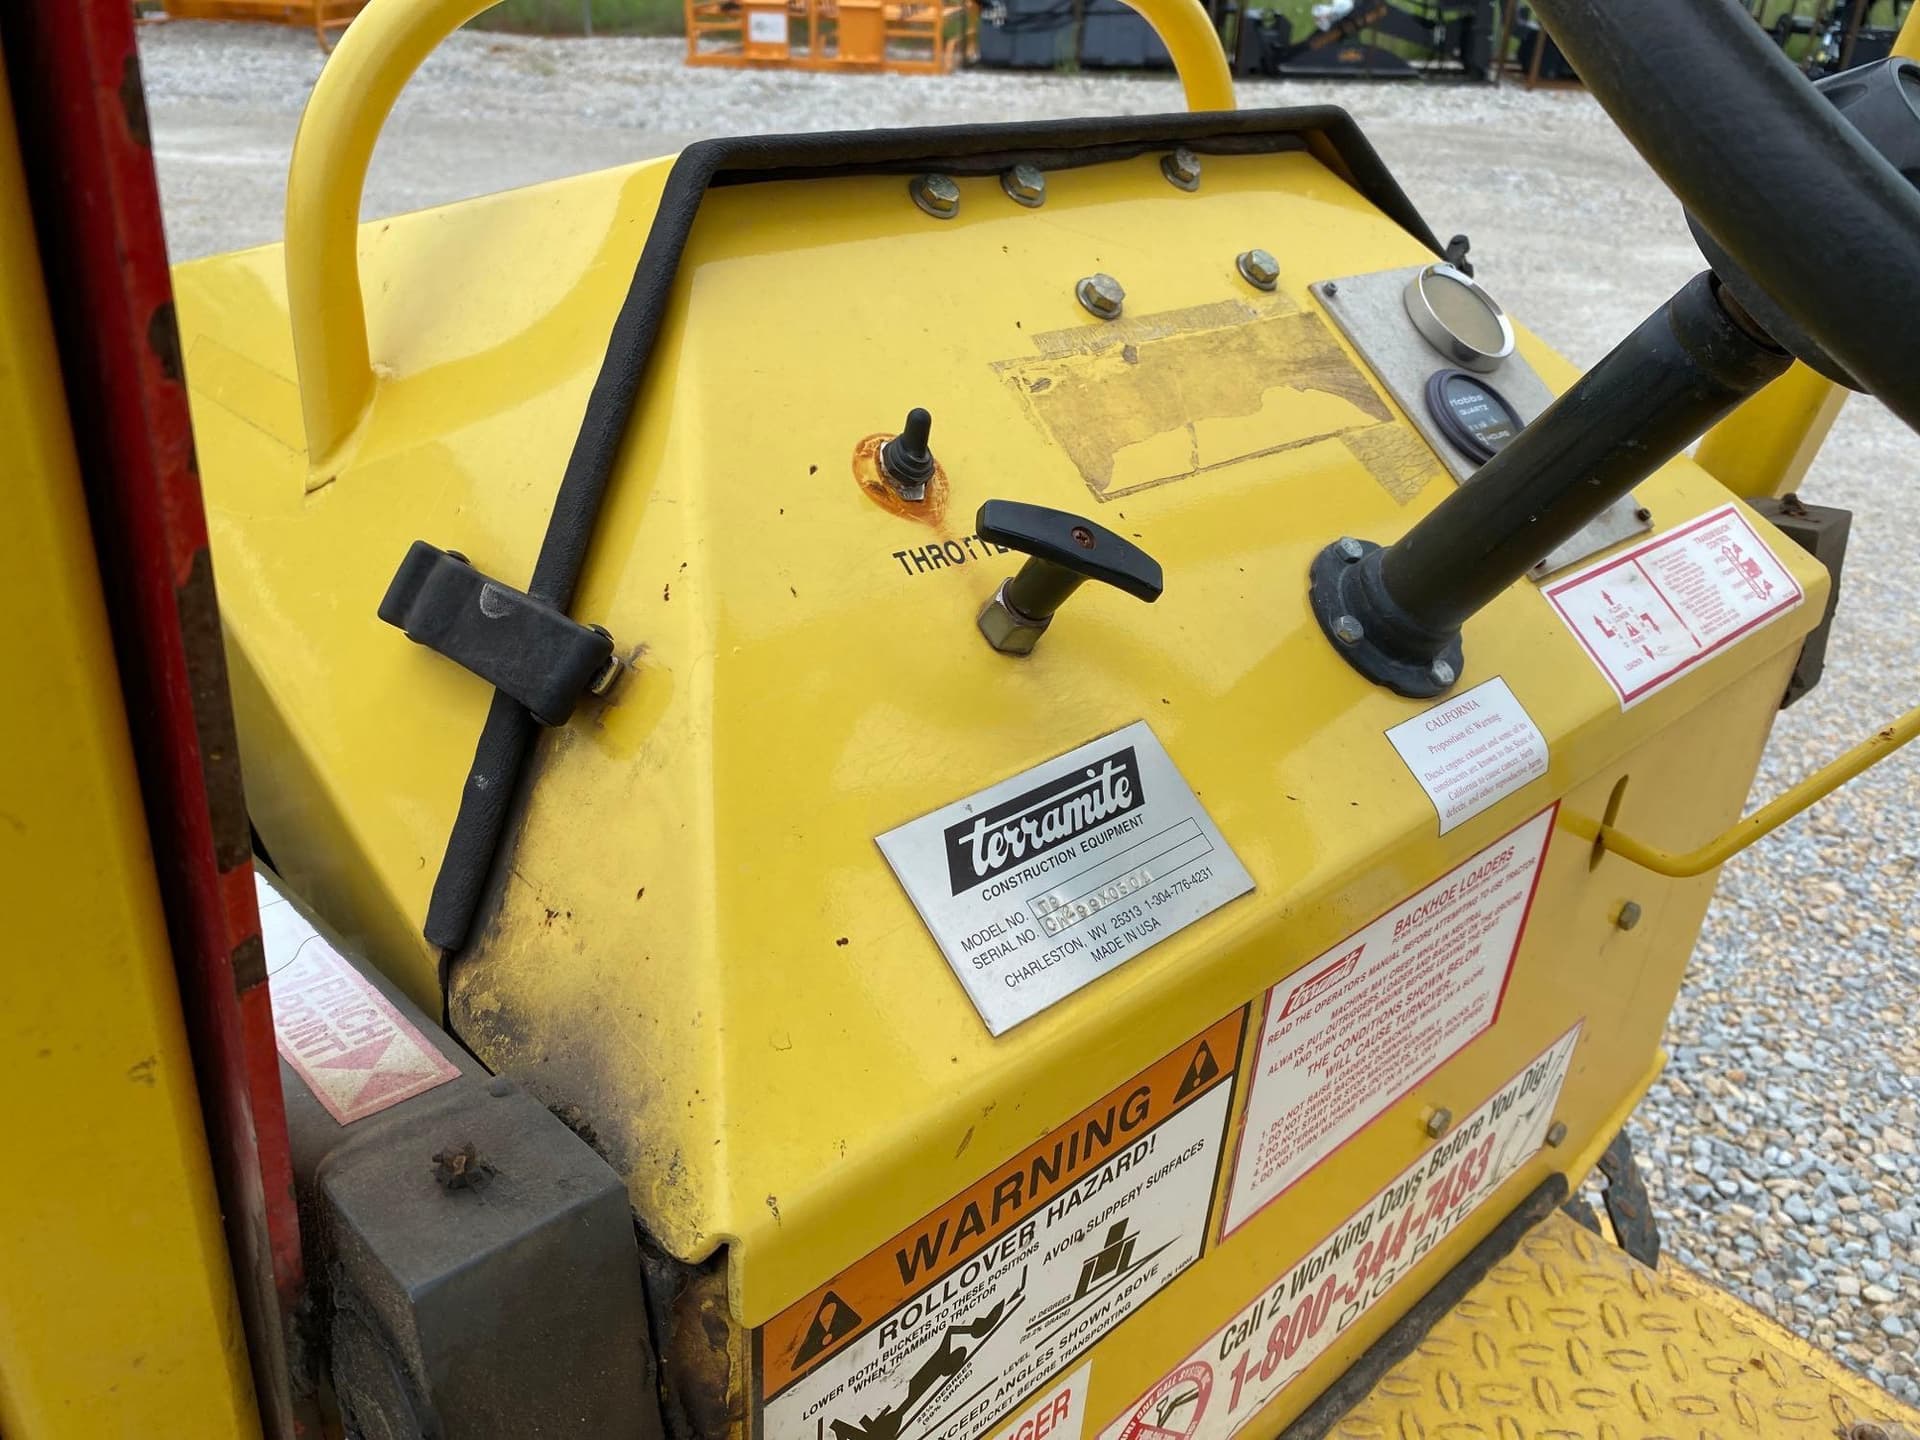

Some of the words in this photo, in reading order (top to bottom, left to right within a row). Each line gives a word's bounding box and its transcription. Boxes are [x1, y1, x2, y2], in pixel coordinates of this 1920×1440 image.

[1424, 699, 1480, 733] CALIFORNIA
[1426, 730, 1466, 756] Proposition
[1423, 764, 1446, 783] Diesel
[1447, 780, 1479, 802] California
[959, 760, 1133, 877] terramite
[982, 847, 1077, 901] CONSTRUCTION
[1080, 813, 1143, 853] EQUIPMENT
[1393, 882, 1458, 937] BACKHOE
[1458, 845, 1516, 894] LOADERS
[960, 923, 1007, 952] MODEL
[1004, 911, 1030, 930] NO.
[972, 940, 1018, 970] SERIAL
[1015, 928, 1041, 947] NO.
[1005, 937, 1088, 987] CHARLESTON,
[1086, 922, 1108, 942] WV
[1110, 905, 1142, 929] 25313
[1144, 867, 1213, 910] 1-304-776-4231
[1090, 936, 1125, 962] MADE
[1122, 928, 1139, 944] IN
[1134, 916, 1162, 937] USA
[303, 976, 395, 1046] PINCH
[1266, 1021, 1293, 1047] READ
[1295, 1007, 1313, 1027] THE
[1367, 949, 1400, 978] MANUAL
[1401, 926, 1434, 954] BEFORE
[1306, 1051, 1331, 1078] THE
[1332, 999, 1404, 1059] CONDITIONS
[1404, 969, 1445, 1006] SHOWN
[1446, 943, 1482, 977] BELOW
[1330, 987, 1370, 1021] MACHINE
[1369, 975, 1388, 993] MAY
[1388, 955, 1416, 980] CREEP
[275, 994, 347, 1060] POINT
[1266, 1043, 1305, 1077] ALWAYS
[1306, 1029, 1324, 1050] PUT
[1292, 1049, 1313, 1070] AND
[1314, 1031, 1338, 1055] TURN
[1338, 1018, 1356, 1038] OFF
[1325, 1052, 1352, 1080] WILL
[1354, 1020, 1394, 1058] CAUSE
[1267, 1128, 1282, 1146] DO
[1283, 1112, 1304, 1134] NOT
[1303, 1090, 1333, 1118] SWING
[1270, 1116, 1285, 1133] DO
[1285, 1100, 1306, 1121] NOT
[1306, 1080, 1332, 1106] RAISE
[1261, 1143, 1290, 1172] AVOID
[1264, 1141, 1280, 1159] DO
[1280, 1125, 1301, 1147] NOT
[895, 1085, 1150, 1287] WARNING
[1042, 1228, 1083, 1266] AVOID
[1086, 1183, 1143, 1233] SLIPPERY
[1146, 1139, 1204, 1189] SURFACES
[1219, 1299, 1265, 1361] Call
[1267, 1283, 1285, 1320] 2
[1290, 1210, 1374, 1300] Working
[1377, 1166, 1425, 1223] Days
[1426, 1115, 1484, 1179] Before
[1489, 1086, 1517, 1125] You
[1518, 1050, 1554, 1100] Dig!
[879, 1220, 1036, 1349] ROLLOVER
[1046, 1133, 1156, 1228] HAZARD!
[1228, 1132, 1496, 1415] 1-800-344-7483
[1336, 1192, 1475, 1334] DIG-RITE
[803, 1384, 844, 1421] LOWER
[848, 1358, 879, 1387] BOTH
[882, 1320, 932, 1362] BUCKETS
[934, 1307, 950, 1324] TO
[952, 1281, 985, 1310] THESE
[988, 1241, 1039, 1285] POSITIONS
[853, 1364, 886, 1394] WHEN
[890, 1320, 946, 1367] TRAMMING
[950, 1283, 996, 1323] TRACTOR
[1038, 1294, 1071, 1318] DEGREES
[935, 1362, 972, 1403] DEGREES
[938, 1399, 990, 1440] XCEED
[994, 1347, 1054, 1401] ANGLES
[1059, 1302, 1111, 1349] SHOWN
[1114, 1263, 1159, 1306] ABOVE
[972, 1394, 1013, 1434] BUCKET
[1017, 1360, 1056, 1397] BEFORE
[1060, 1301, 1131, 1362] TRANSPORTING
[1003, 1352, 1029, 1376] LEVEL
[942, 1370, 973, 1402] GRADE)
